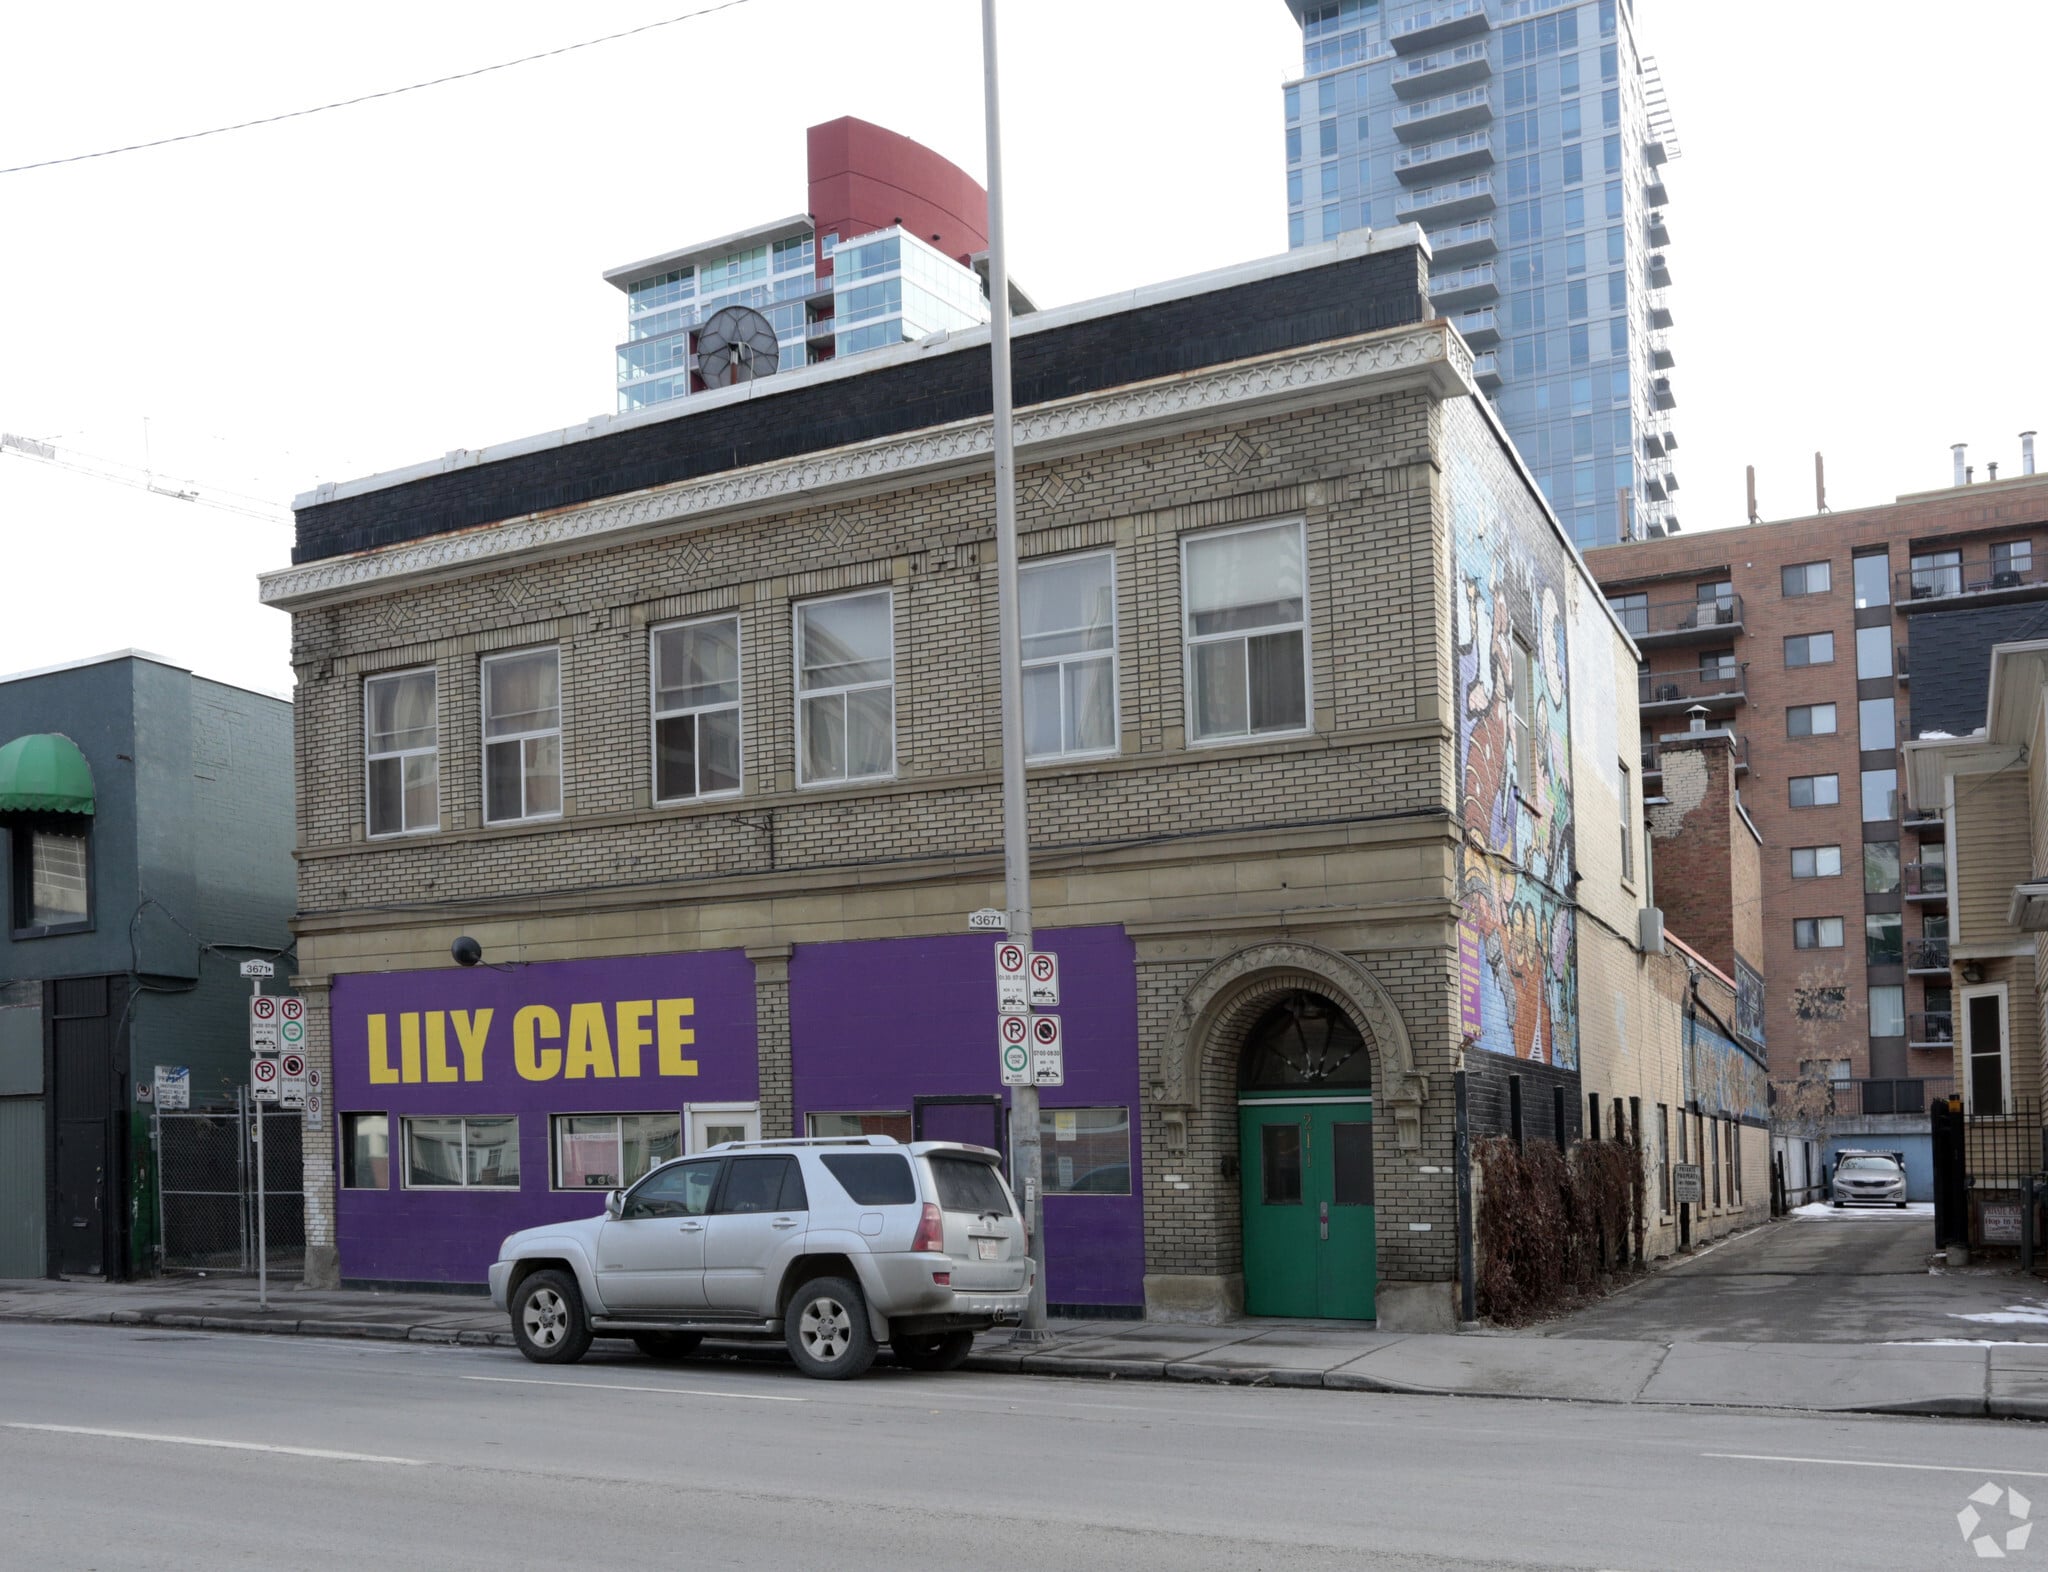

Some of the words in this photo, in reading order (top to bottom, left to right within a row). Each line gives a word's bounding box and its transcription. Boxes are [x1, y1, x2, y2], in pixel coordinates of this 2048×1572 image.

[975, 915, 1002, 926] 3671
[246, 965, 269, 974] 3671
[367, 1008, 494, 1084] LILY
[513, 998, 698, 1081] CAFE
[1303, 1112, 1312, 1168] 211
